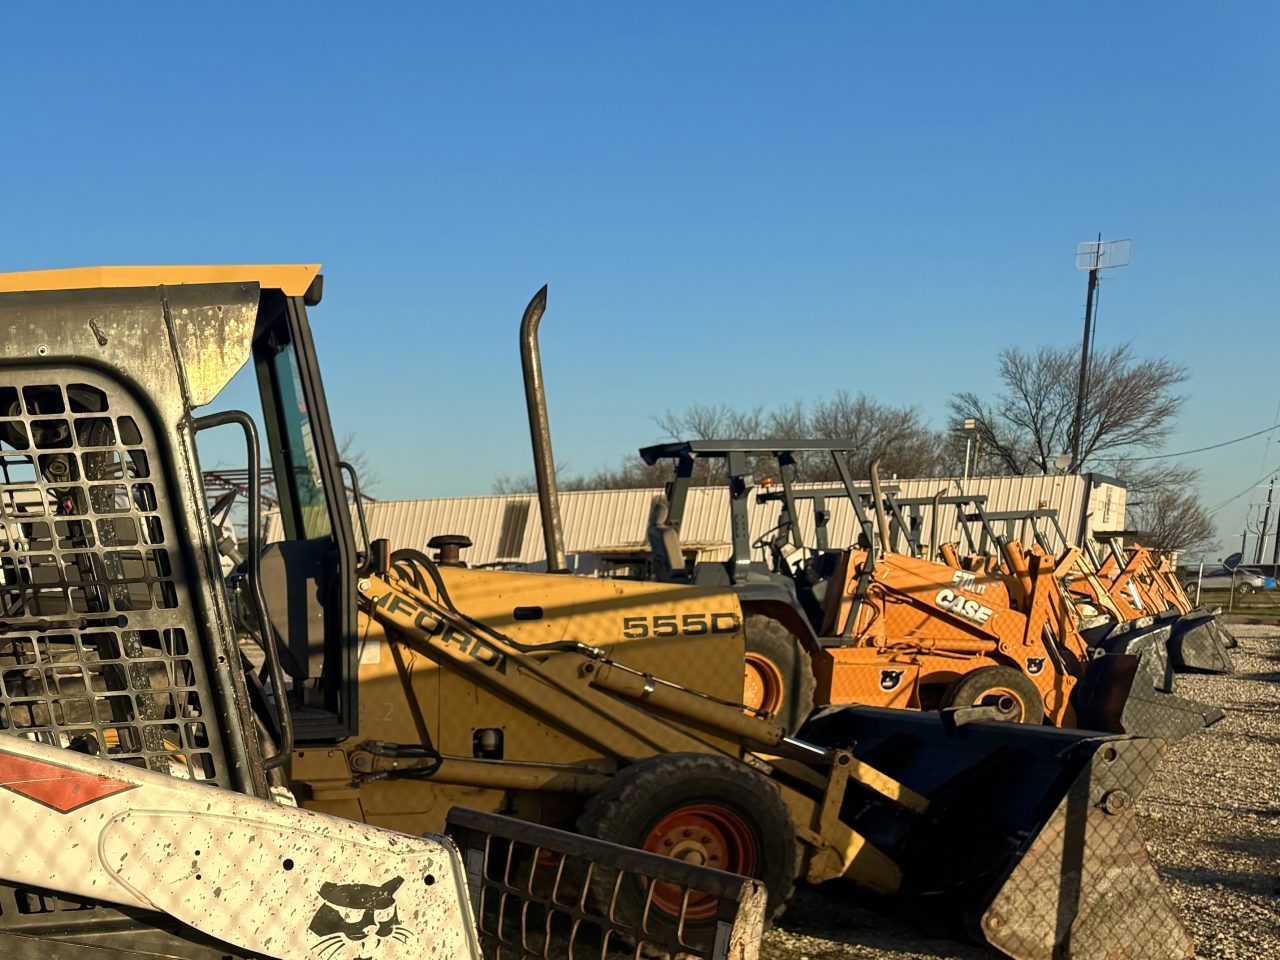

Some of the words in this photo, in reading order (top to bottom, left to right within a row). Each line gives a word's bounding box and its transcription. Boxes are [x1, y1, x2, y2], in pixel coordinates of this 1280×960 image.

[935, 588, 994, 625] CASE
[387, 594, 500, 668] FORD
[623, 612, 740, 639] 555D
